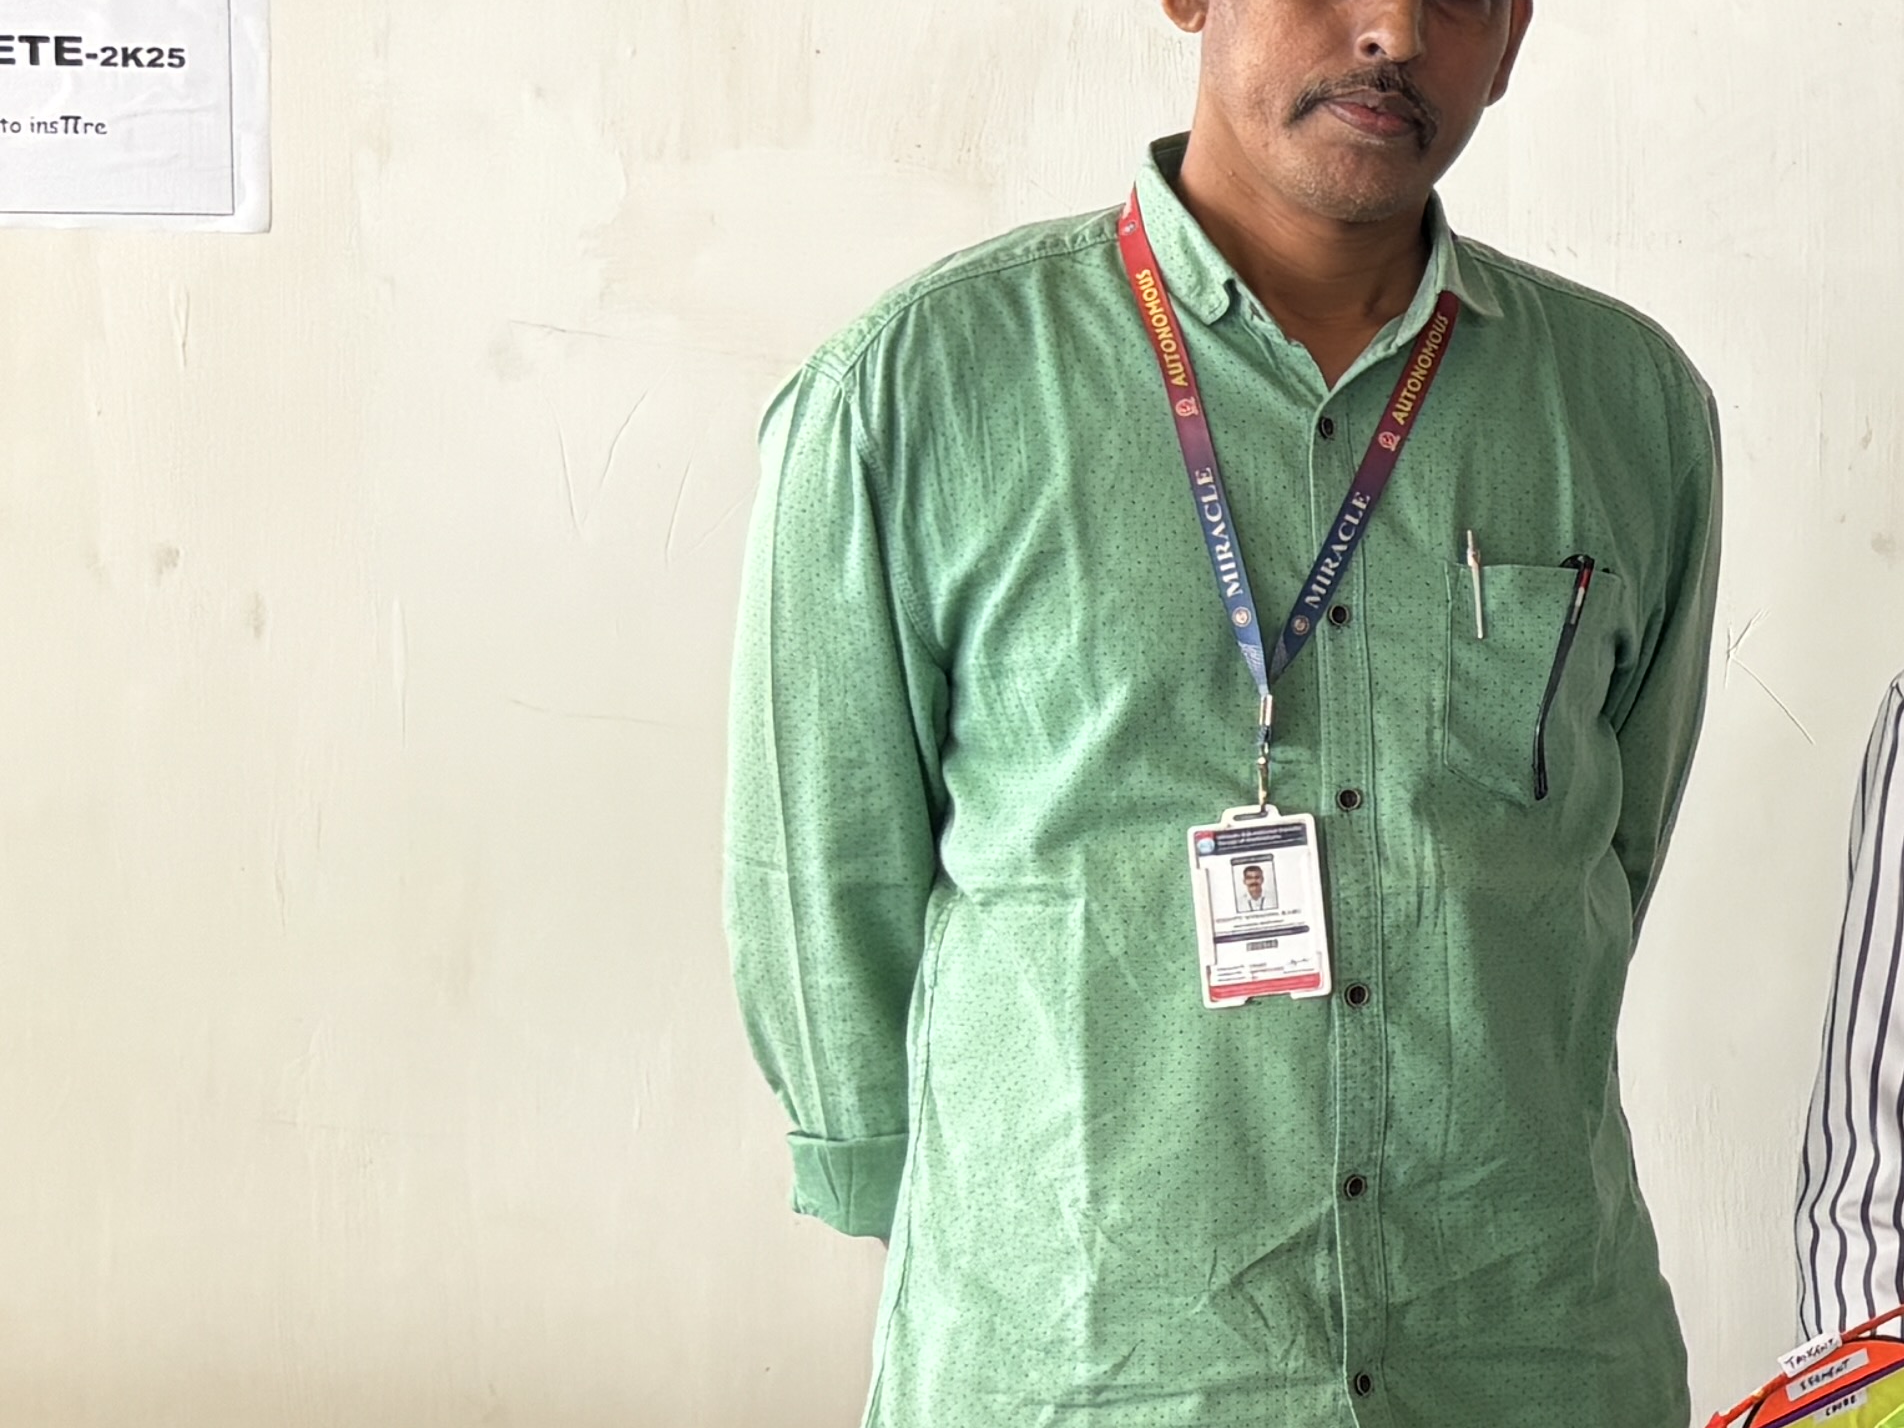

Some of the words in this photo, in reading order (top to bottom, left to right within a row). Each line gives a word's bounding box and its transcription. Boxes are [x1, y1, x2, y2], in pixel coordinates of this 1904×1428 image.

[1136, 269, 1188, 387] AUTONOMOUS
[1391, 313, 1449, 425] AUTONOMOUS
[1195, 467, 1243, 598] MIRACLE
[1304, 491, 1371, 609] MIRACLE
